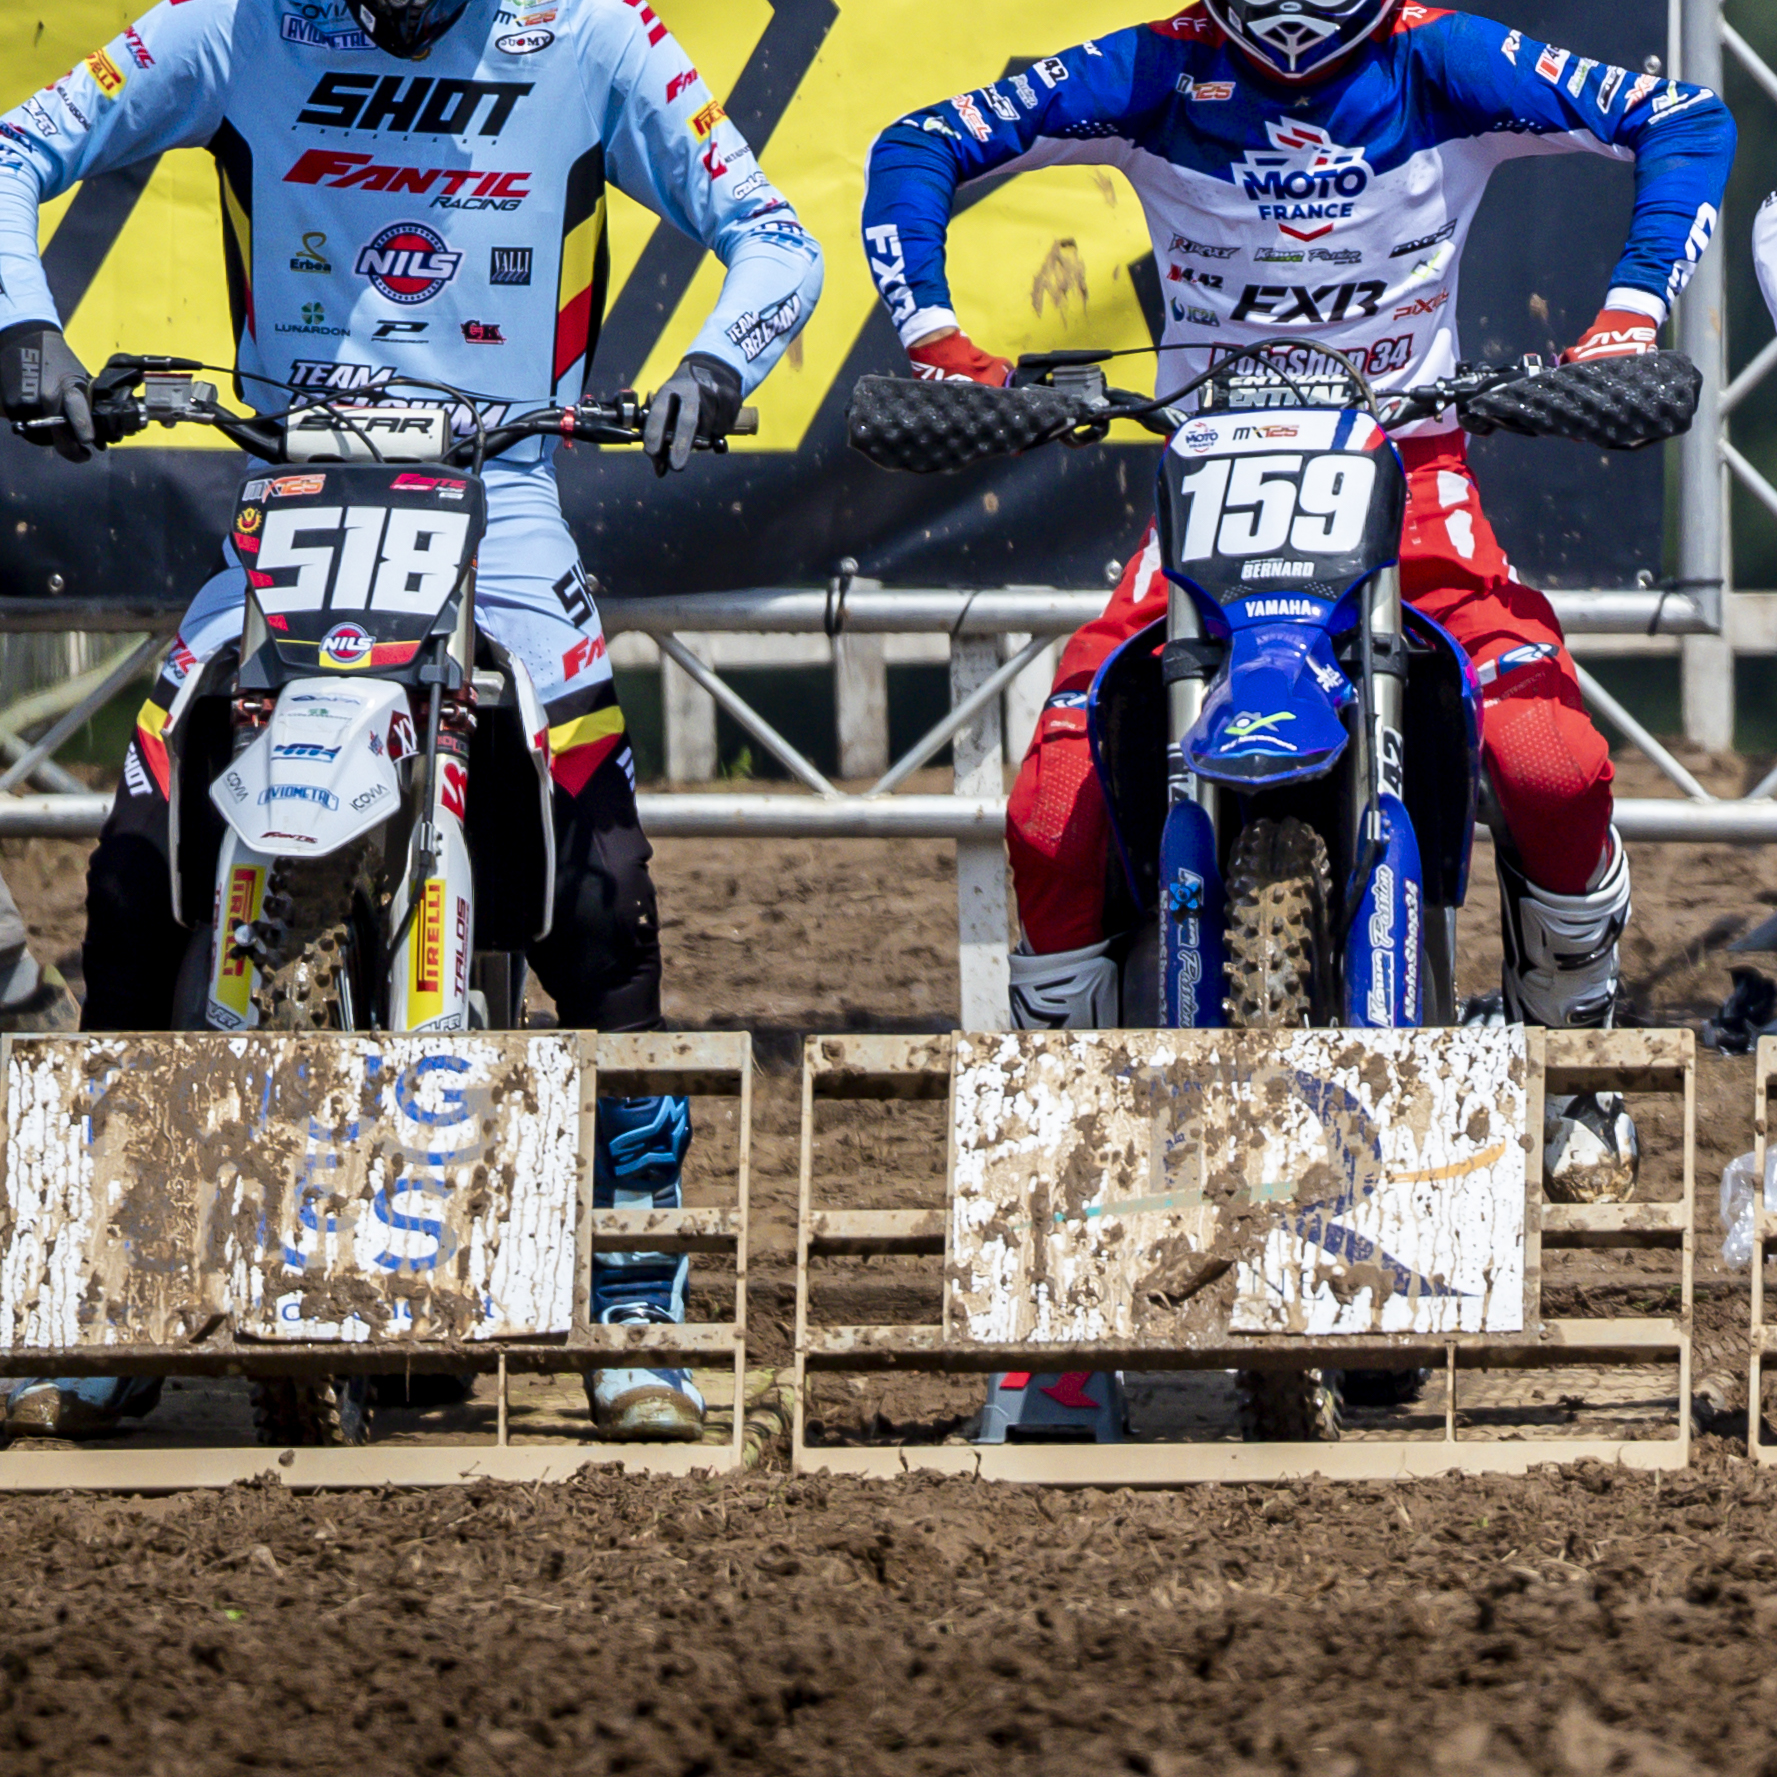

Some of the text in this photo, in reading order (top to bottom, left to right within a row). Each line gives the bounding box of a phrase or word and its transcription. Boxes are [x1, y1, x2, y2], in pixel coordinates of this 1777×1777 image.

[296, 71, 536, 137] SHOT
[282, 148, 533, 198] FANTIC
[1243, 166, 1368, 201] MOTO
[429, 196, 523, 212] RACING
[1258, 202, 1354, 221] FRANCE
[358, 248, 460, 279] NILS
[494, 249, 530, 273] VALLI
[1229, 280, 1388, 324] FXR
[274, 323, 351, 337] LUNARDON
[1363, 332, 1411, 374] 34
[1182, 431, 1213, 445] MOTO
[1180, 454, 1377, 561] 159
[255, 505, 471, 616] 518
[1239, 561, 1315, 580] BERNARD
[1244, 599, 1313, 618] YAMAHA
[322, 636, 376, 652] NILS
[350, 783, 388, 812] ICOVIA
[416, 883, 441, 992] PIRELLI
